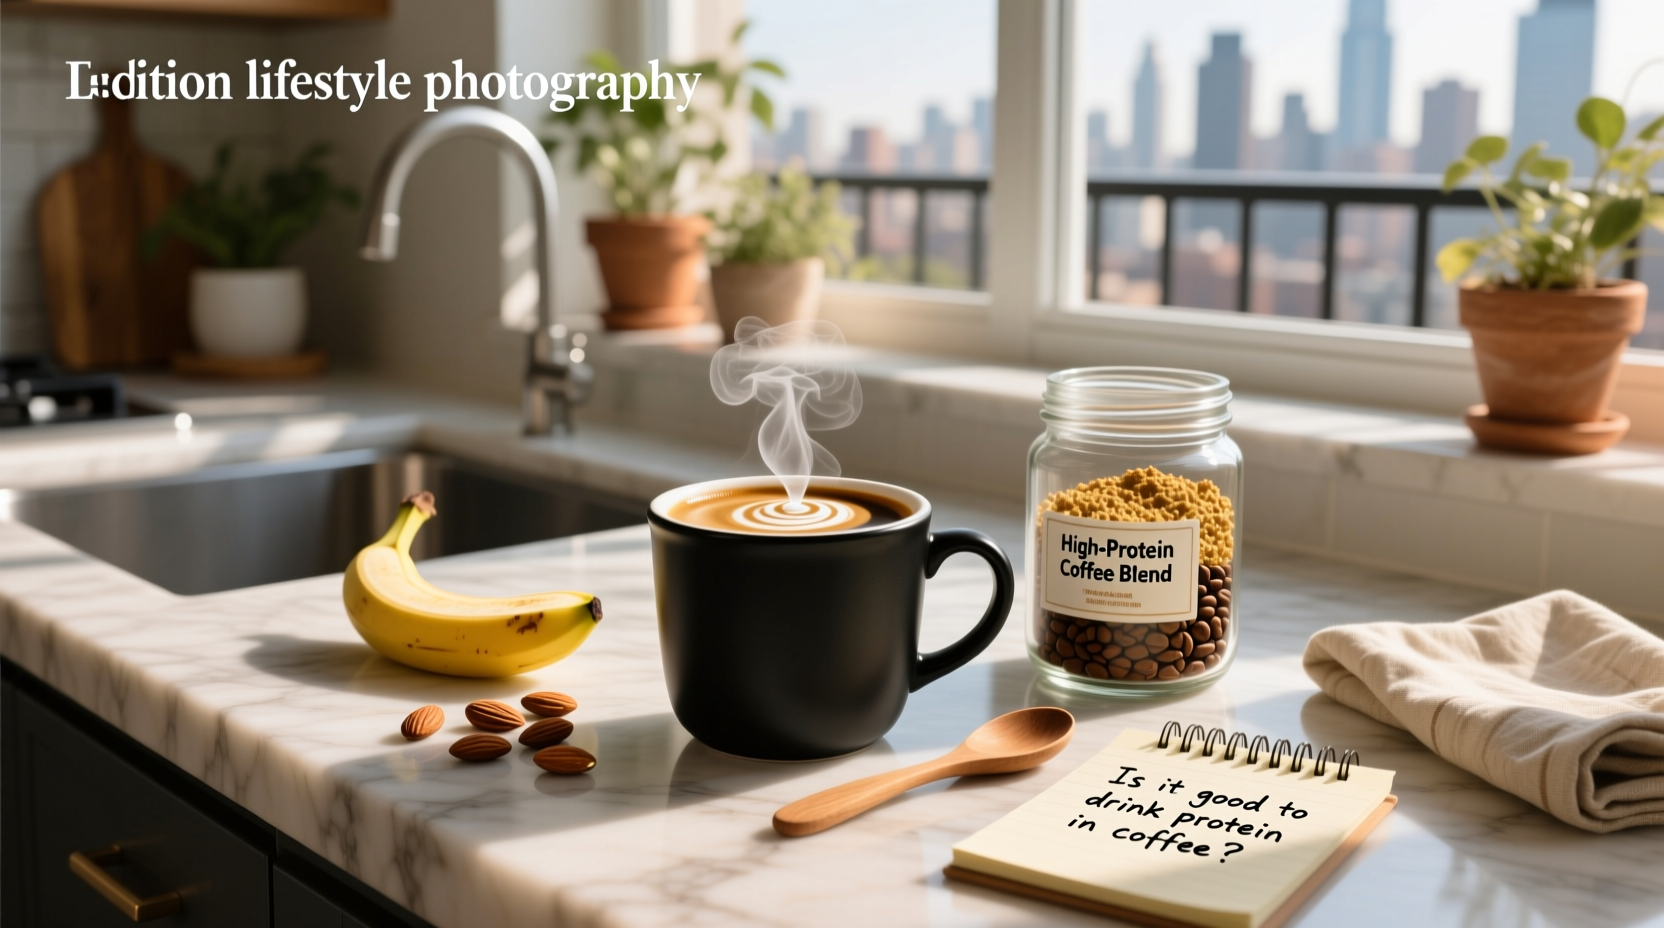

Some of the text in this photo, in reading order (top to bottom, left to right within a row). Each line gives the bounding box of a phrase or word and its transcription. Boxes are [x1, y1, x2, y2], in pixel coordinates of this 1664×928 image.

[1061, 533, 1174, 560] High-Protein
[1060, 558, 1172, 583] Coffee Blend
[1108, 766, 1309, 820] Is it good to
[1067, 814, 1096, 832] in
[1085, 791, 1283, 844] drink protein
